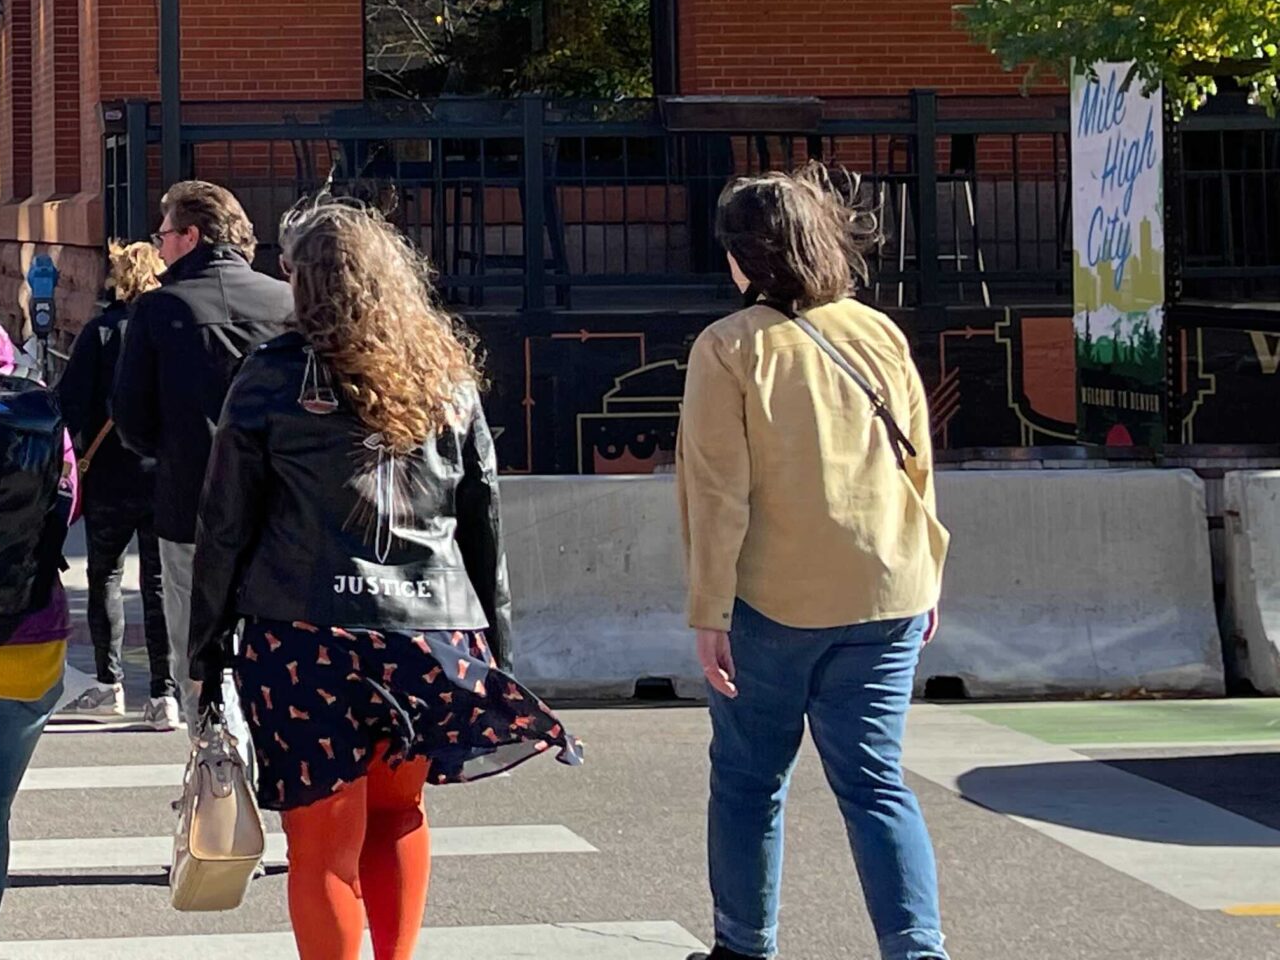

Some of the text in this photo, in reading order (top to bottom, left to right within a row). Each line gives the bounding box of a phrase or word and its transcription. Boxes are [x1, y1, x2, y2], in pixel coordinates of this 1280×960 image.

[1077, 69, 1126, 138] Mile
[1100, 105, 1157, 217] High
[1087, 205, 1132, 292] City
[1081, 386, 1115, 408] WELCOME
[1118, 390, 1128, 409] TO
[333, 575, 432, 598] JUSTICE
